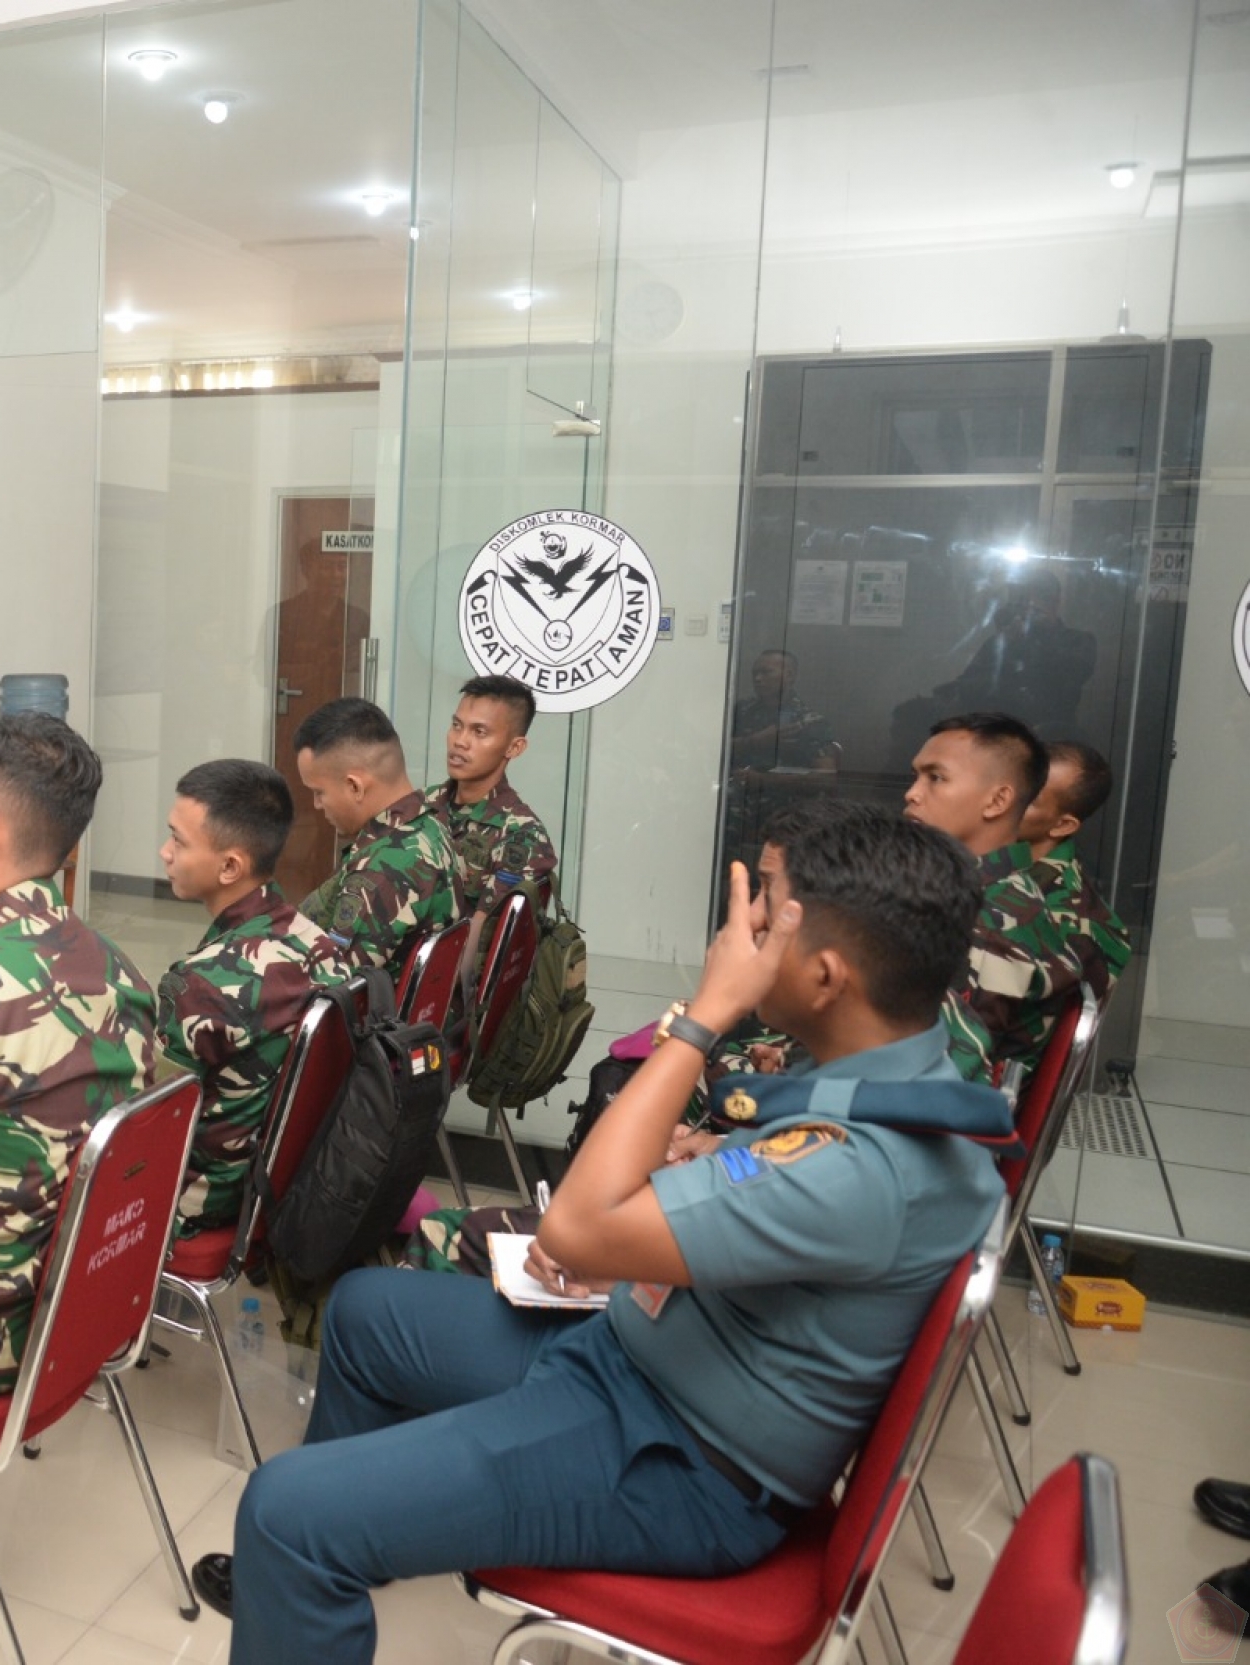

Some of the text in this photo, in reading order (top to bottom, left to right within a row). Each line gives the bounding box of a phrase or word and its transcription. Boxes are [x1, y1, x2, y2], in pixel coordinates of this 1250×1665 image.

[325, 534, 374, 549] KASATKO
[488, 512, 627, 552] DISKOMLEK KORMAR
[470, 594, 511, 666] CEPAT
[608, 589, 645, 664] AMAN
[521, 658, 596, 690] TEPAT
